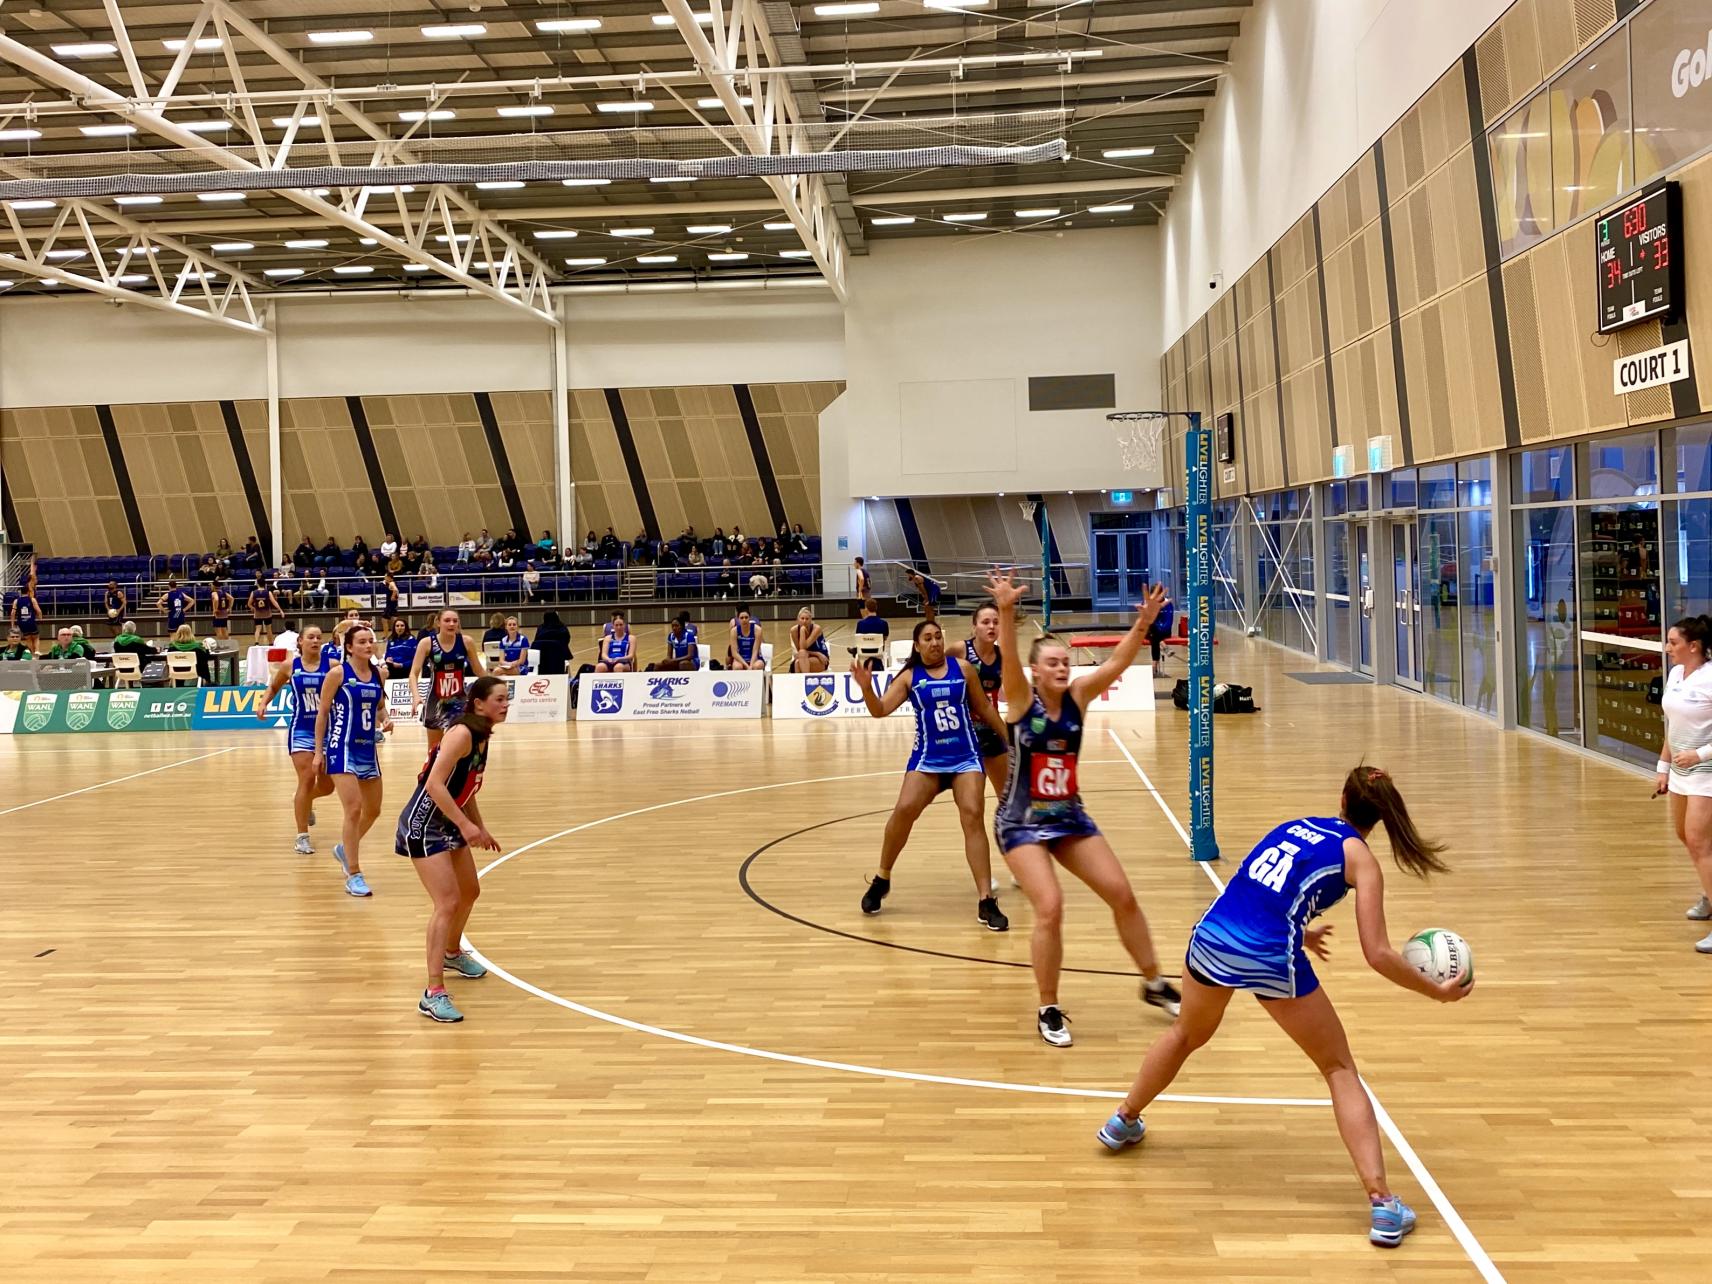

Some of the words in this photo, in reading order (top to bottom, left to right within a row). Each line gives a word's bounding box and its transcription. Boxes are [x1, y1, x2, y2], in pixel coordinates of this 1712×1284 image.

[1602, 219, 1609, 241] 3
[1638, 223, 1667, 246] VISITORS
[1600, 246, 1616, 264] HOME
[1653, 237, 1669, 270] 33
[1607, 258, 1621, 289] 34
[1620, 352, 1667, 387] COURT
[1673, 348, 1681, 374] 1
[1199, 433, 1209, 505] LIVELIGHTER
[1199, 515, 1208, 586] LIVELIGHTER
[1199, 596, 1209, 666] LIVELIGHTER
[439, 678, 460, 697] WD
[646, 677, 690, 686] SHARKS
[111, 702, 136, 710] WANL
[361, 709, 372, 731] C
[933, 706, 960, 732] GS
[1200, 675, 1210, 748] LIVELIGHTER
[330, 702, 345, 749] SHARKS
[1037, 768, 1071, 797] GK
[1201, 757, 1211, 829] LIVELIGHTER
[1286, 824, 1327, 845] COSH
[1248, 846, 1294, 893] GA
